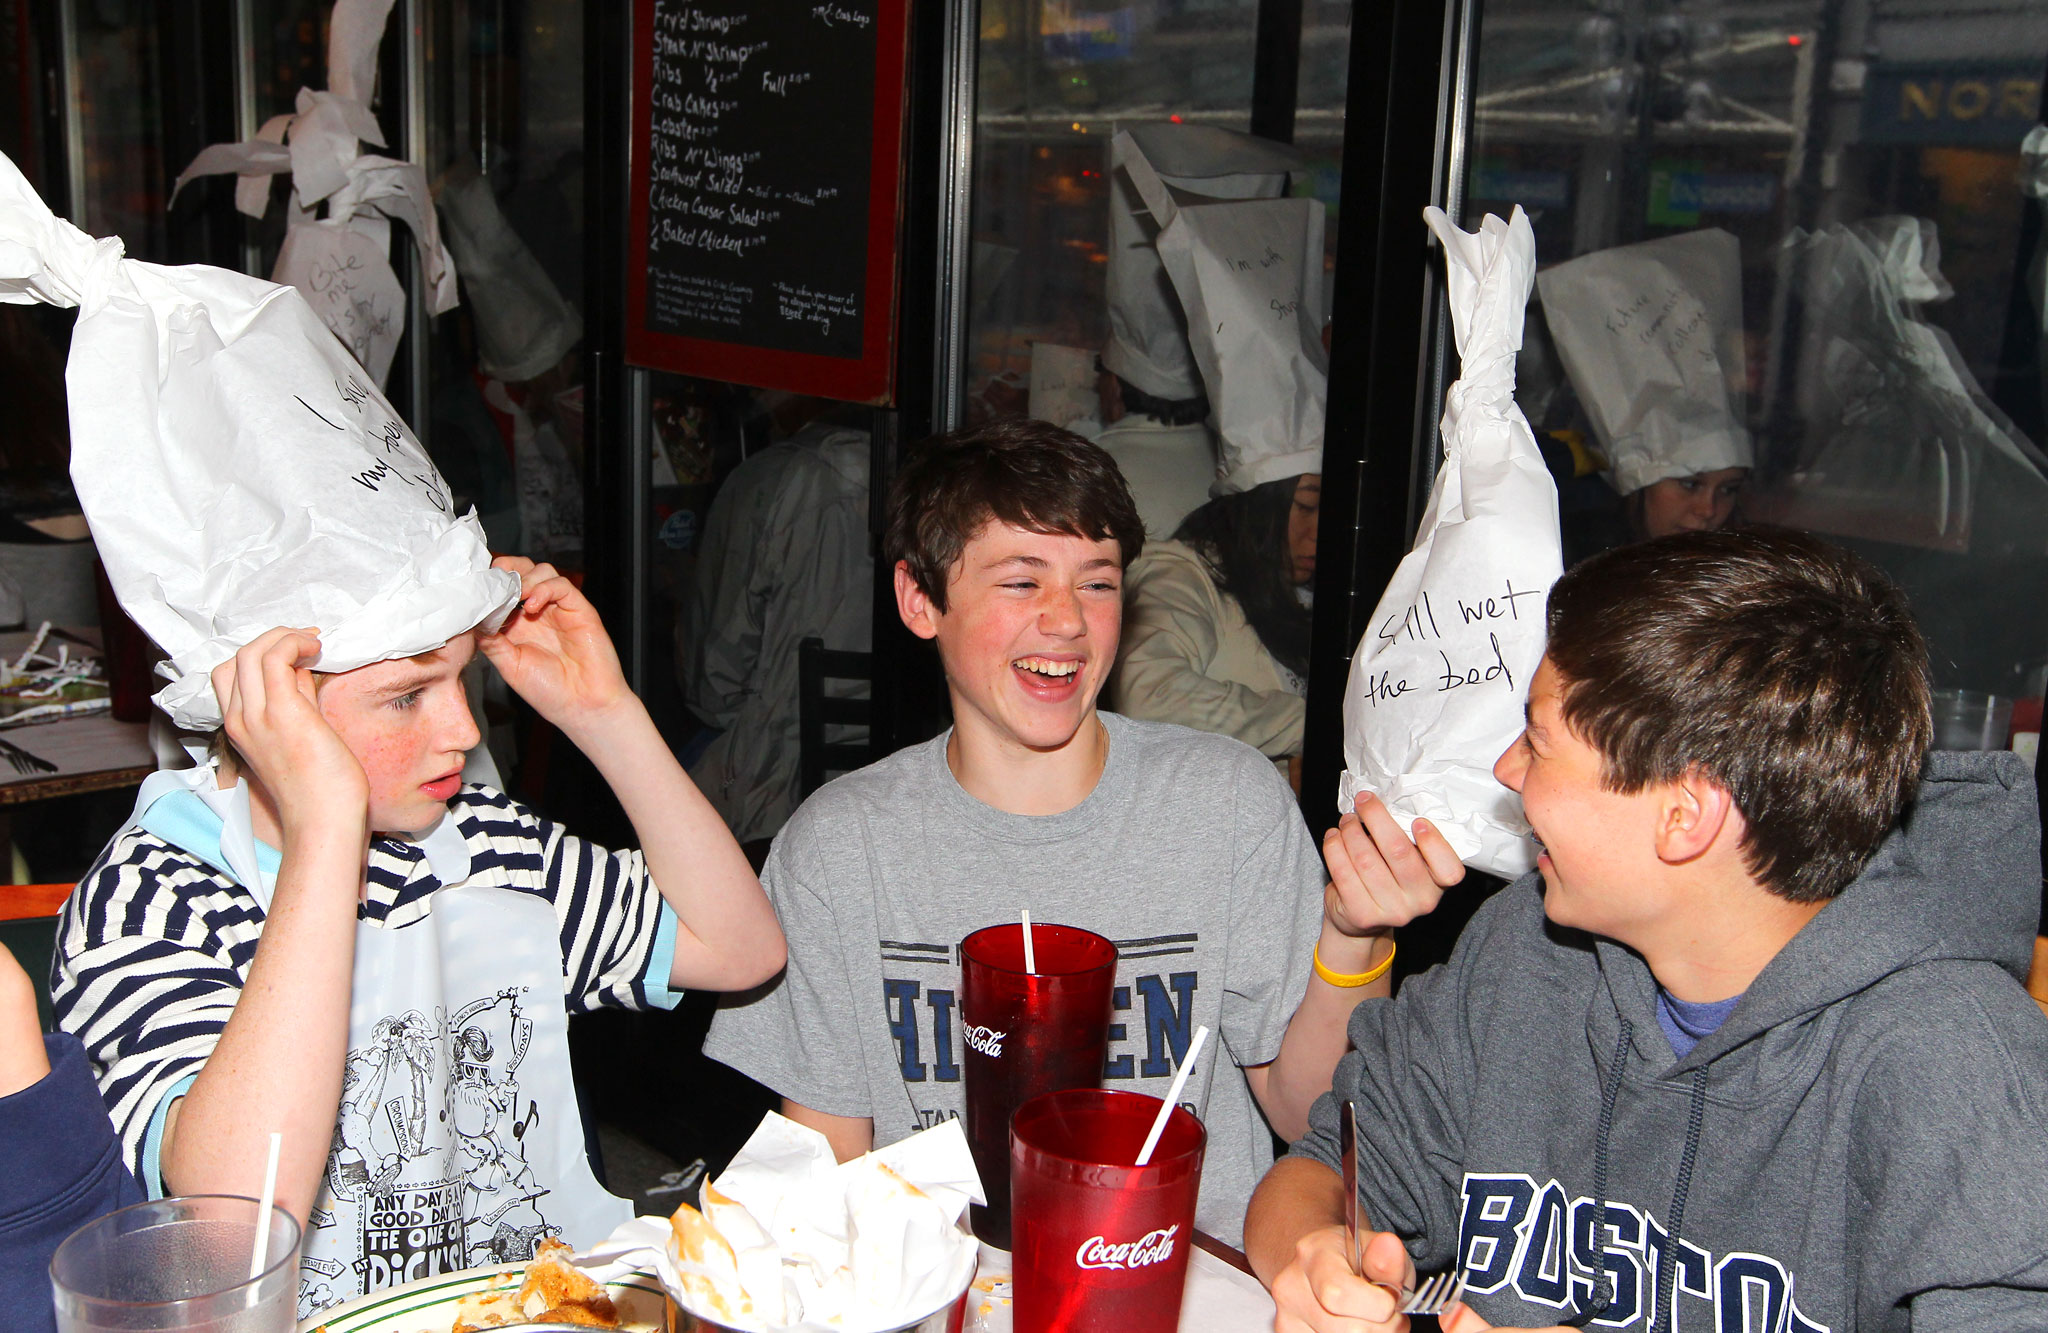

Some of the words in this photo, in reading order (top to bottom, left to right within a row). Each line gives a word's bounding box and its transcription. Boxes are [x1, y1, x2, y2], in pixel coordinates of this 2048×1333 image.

[691, 9, 729, 35] Shrimp
[653, 55, 682, 85] Ribs
[762, 71, 787, 97] Full
[651, 83, 681, 112] Crab
[685, 92, 719, 118] Cakes
[650, 111, 699, 142] Lobster
[651, 133, 678, 163] Ribs
[704, 144, 744, 183] Wings
[705, 172, 744, 195] Salad
[650, 184, 688, 213] Chicken
[692, 196, 724, 220] Caesar
[728, 203, 759, 227] Salad
[662, 218, 695, 246] Baked
[698, 229, 743, 257] Chicken
[309, 254, 364, 292] Bite
[328, 279, 357, 304] me
[351, 457, 416, 491] my
[1458, 579, 1541, 624] wet
[1364, 670, 1419, 707] the
[1438, 632, 1514, 691] bed
[370, 1211, 424, 1228] GOOD
[432, 1205, 451, 1224] DAY
[453, 1201, 462, 1218] TO
[374, 1194, 406, 1212] ANY
[414, 1190, 442, 1209] DAY
[445, 1188, 453, 1204] IS
[454, 1186, 460, 1201] A
[408, 1224, 445, 1248] ONE
[448, 1220, 462, 1240] ON
[1076, 1223, 1180, 1270] Coca-Cola
[323, 1264, 336, 1273] EVE
[354, 1259, 369, 1273] AT
[1457, 1172, 1830, 1333] BOSTO
